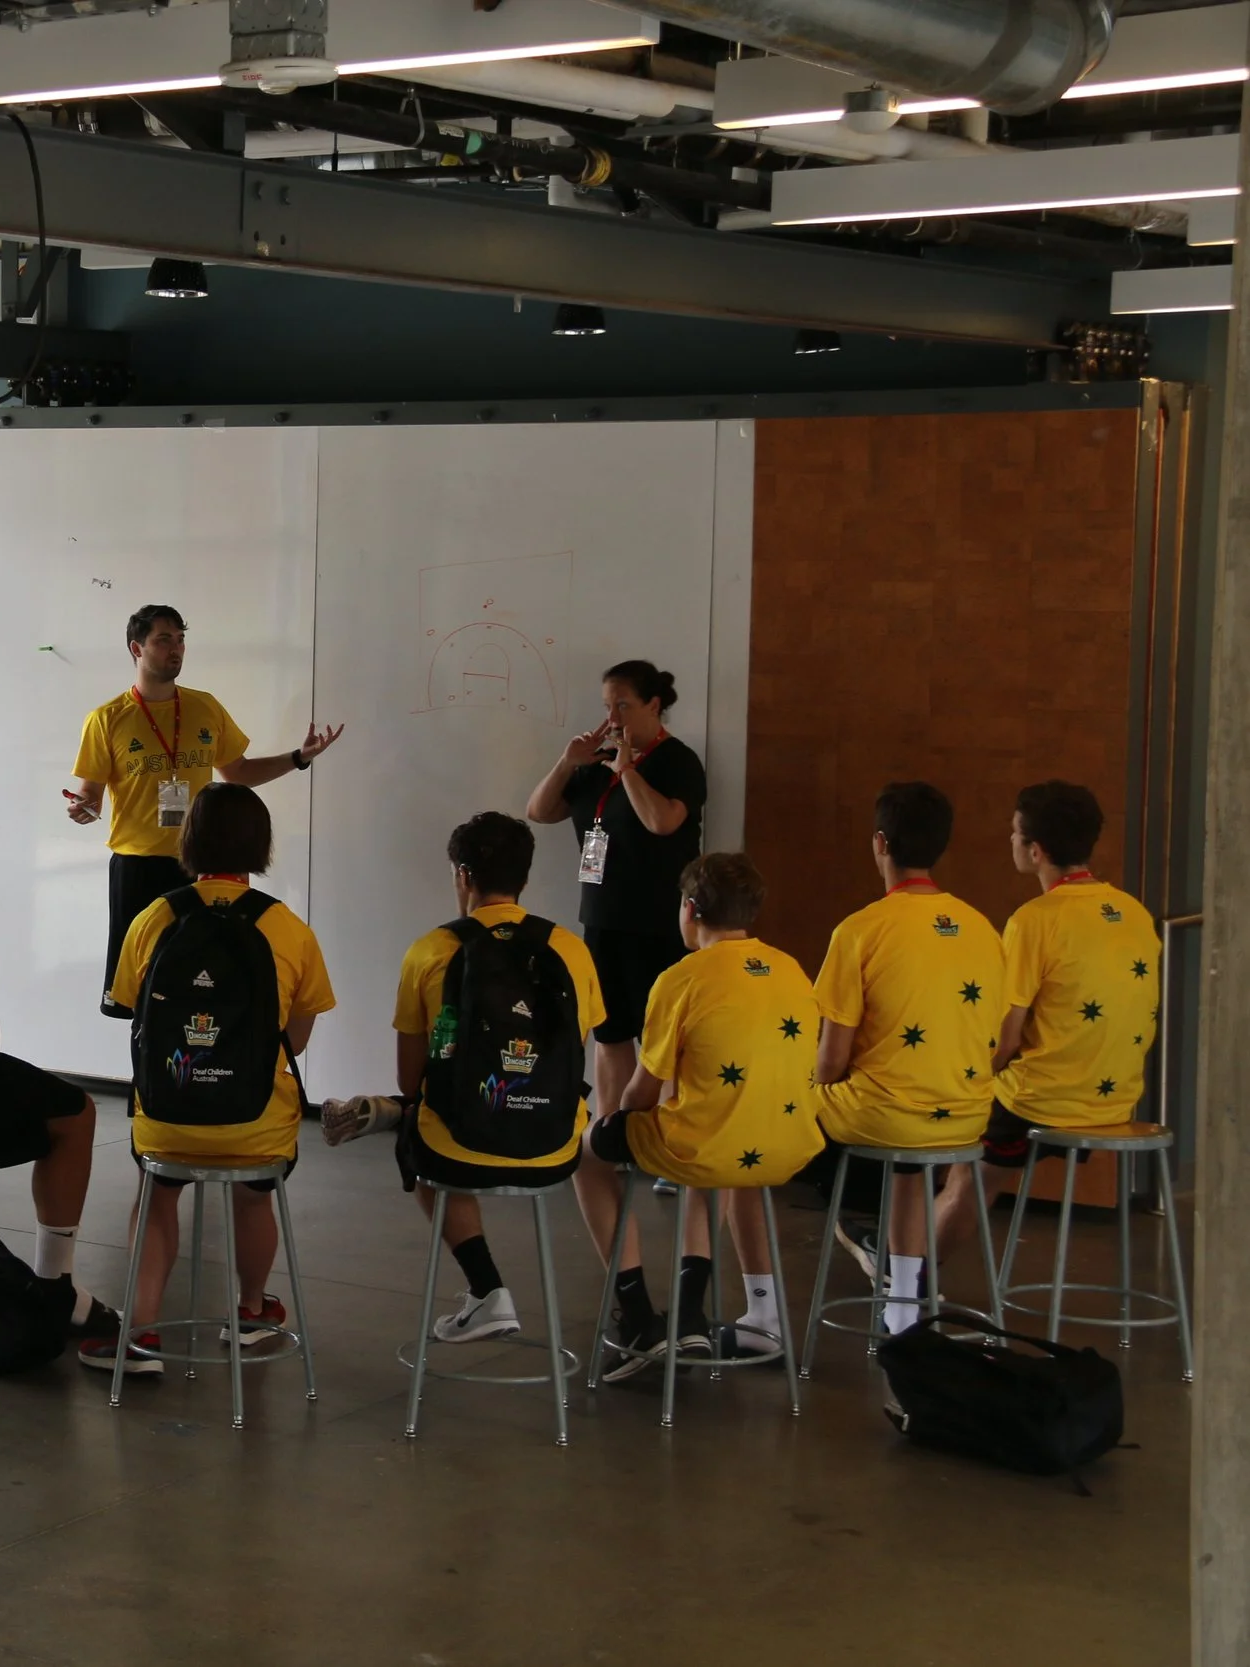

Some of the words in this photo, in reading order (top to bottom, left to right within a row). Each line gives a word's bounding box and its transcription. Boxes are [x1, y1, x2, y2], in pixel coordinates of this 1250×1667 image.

[126, 750, 214, 776] AUSTRALI
[188, 1031, 215, 1040] DINGOES
[504, 1057, 532, 1067] DINGOES
[207, 1068, 234, 1076] Children
[523, 1096, 550, 1104] Children
[506, 1102, 533, 1110] Australia
